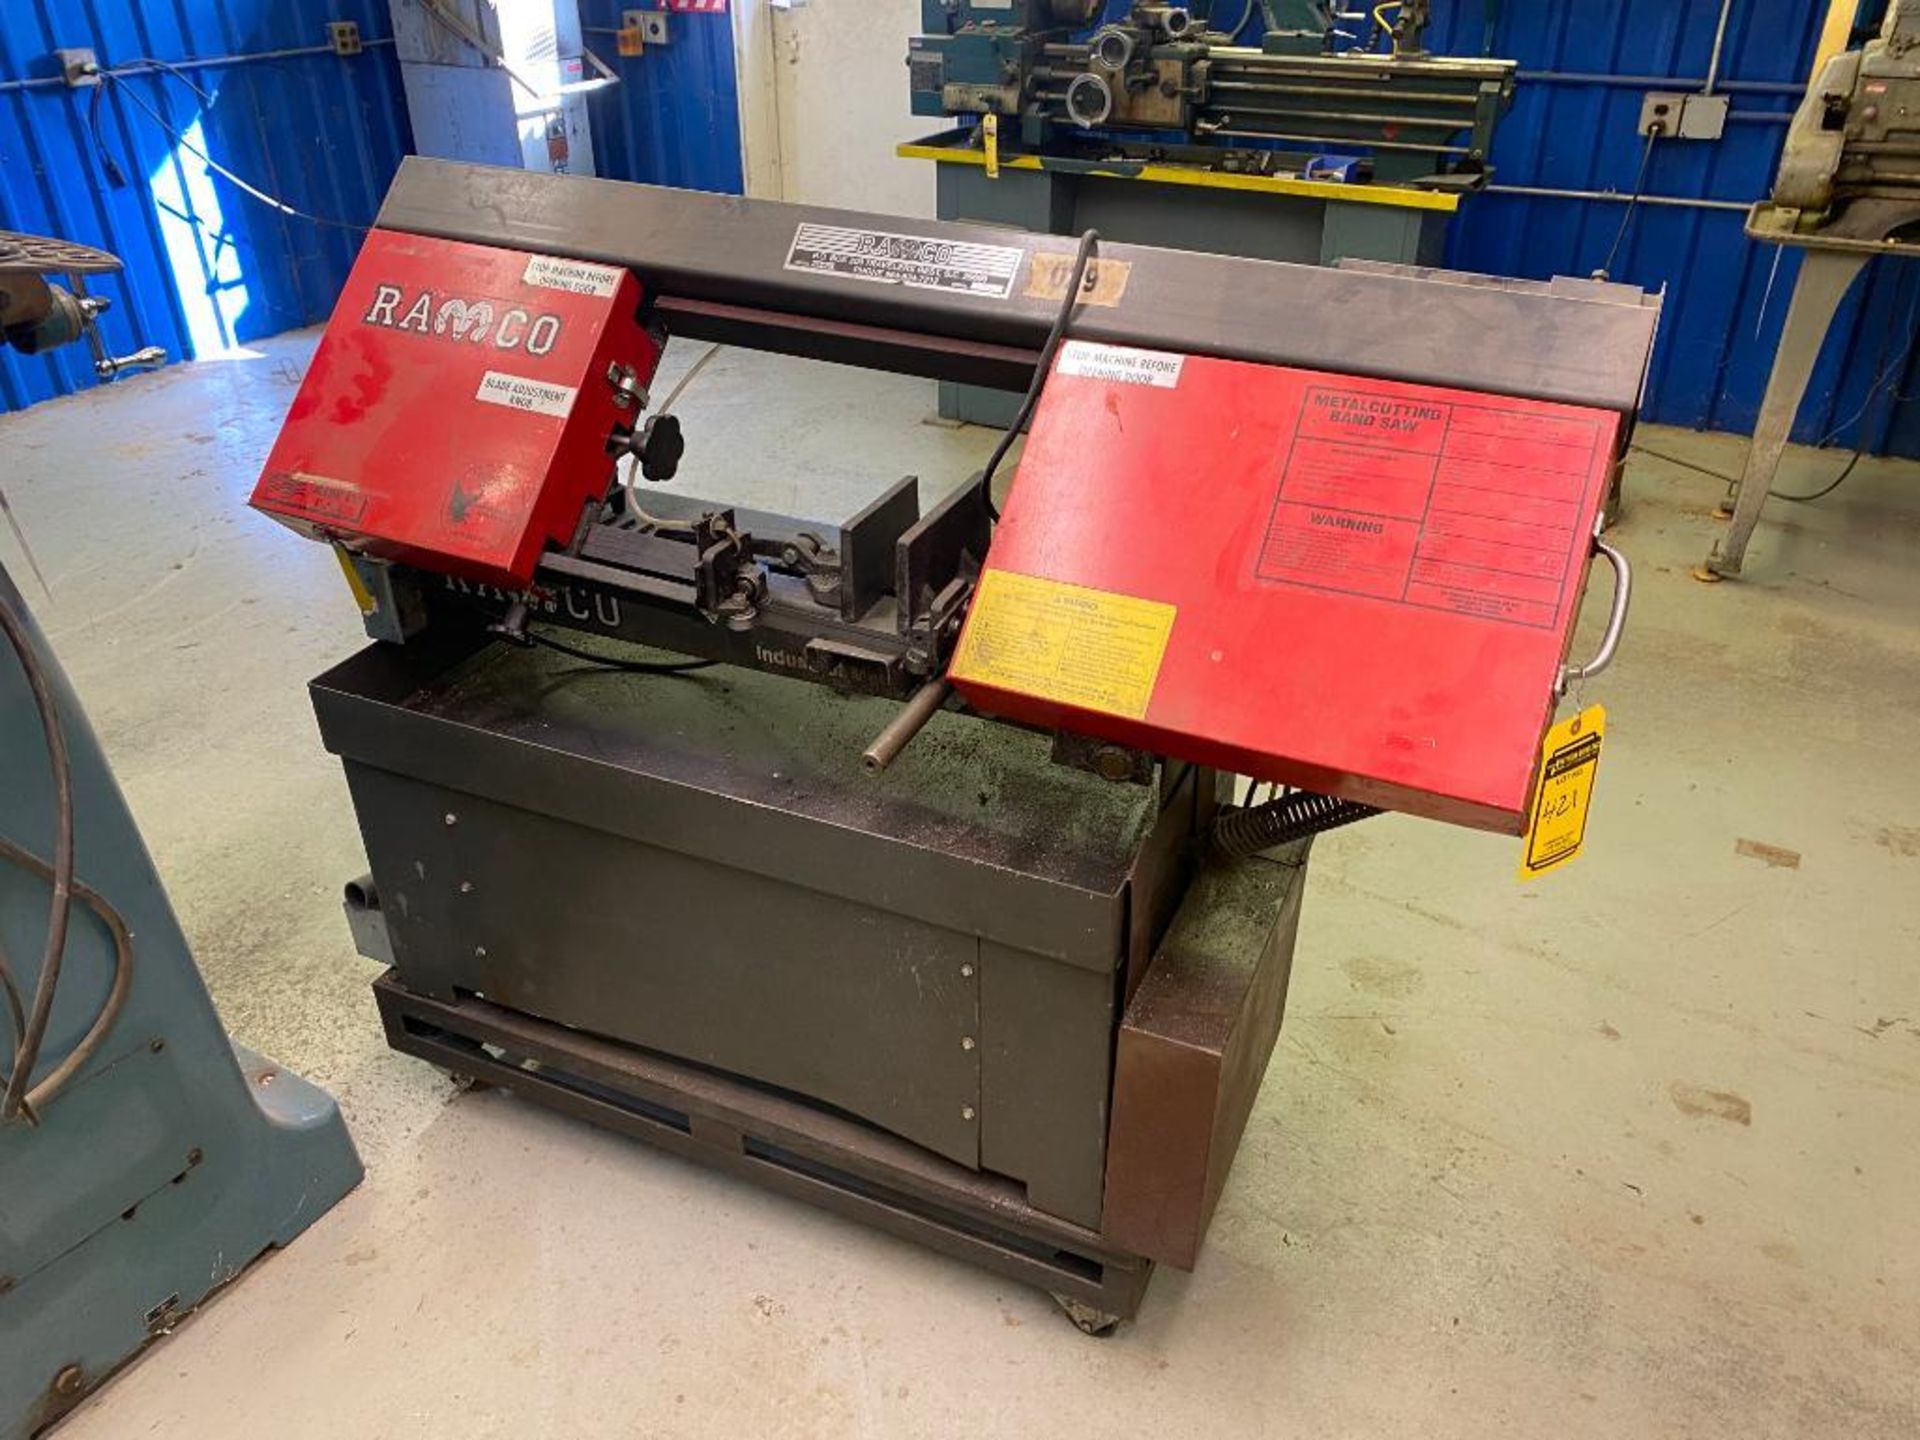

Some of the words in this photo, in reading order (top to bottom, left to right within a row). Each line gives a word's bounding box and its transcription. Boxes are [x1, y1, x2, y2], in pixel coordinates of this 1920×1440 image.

[1050, 266, 1098, 292] 09
[365, 284, 562, 356] RAMCO
[1095, 353, 1137, 368] MACHINE
[1139, 358, 1178, 374] BEFORE
[484, 377, 511, 392] BLADE
[511, 382, 567, 402] ADJUSTMENT
[1313, 394, 1442, 421] METALCUTTING
[1329, 410, 1376, 428] BAND
[1379, 415, 1420, 433] SAW
[1308, 511, 1385, 535] WARNING
